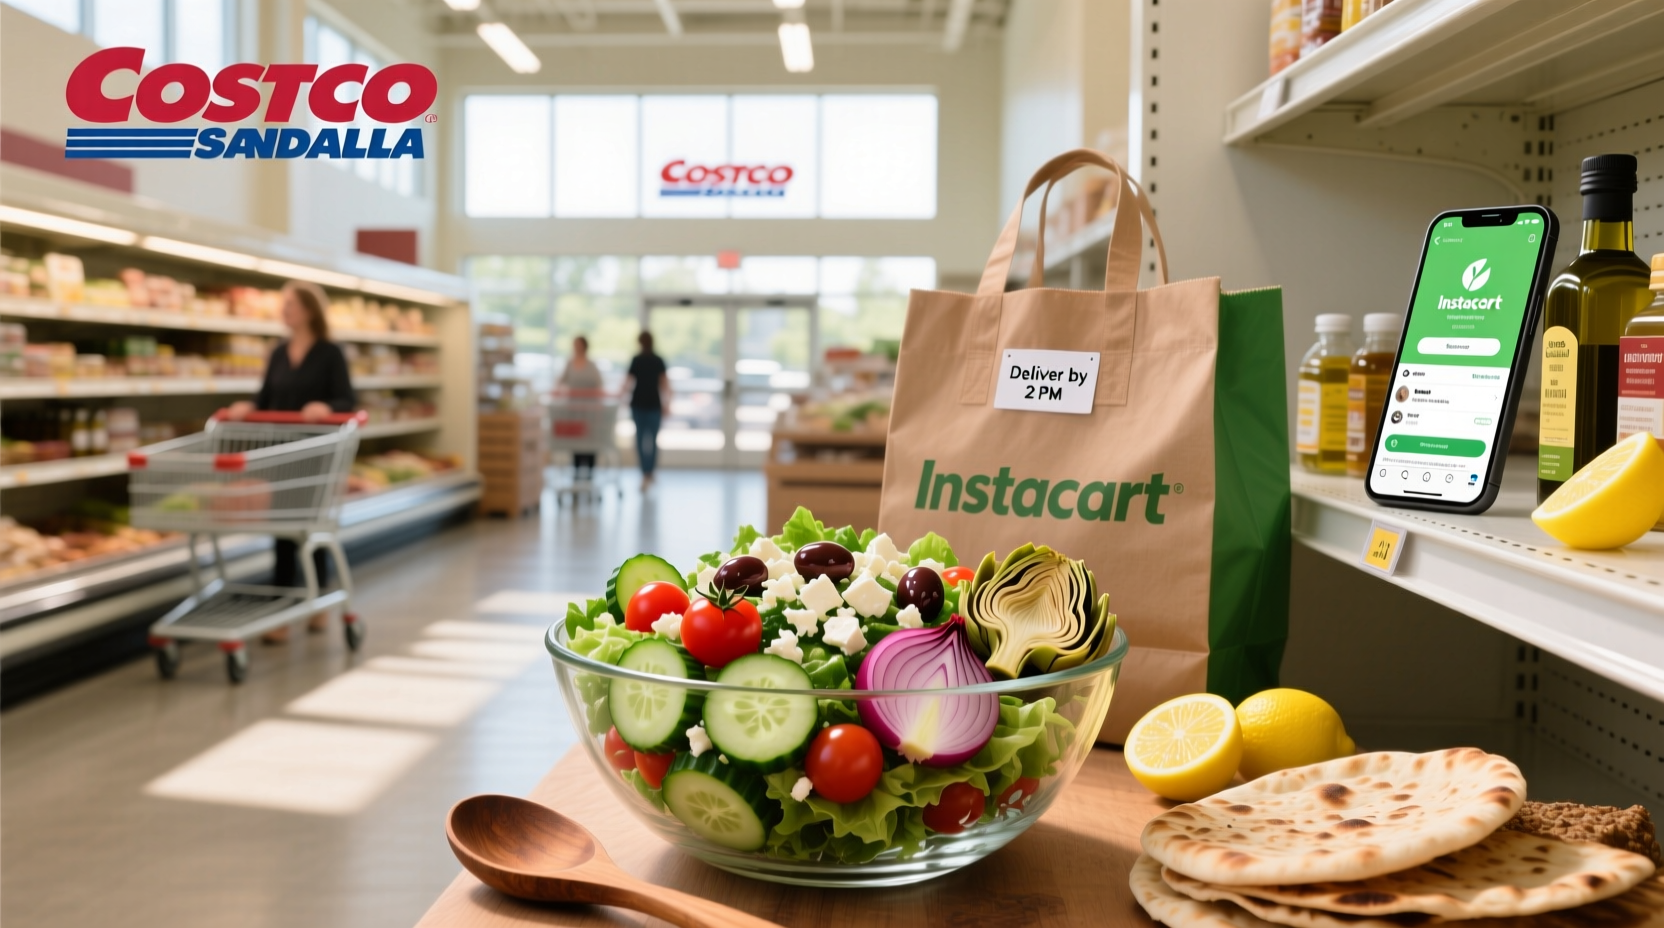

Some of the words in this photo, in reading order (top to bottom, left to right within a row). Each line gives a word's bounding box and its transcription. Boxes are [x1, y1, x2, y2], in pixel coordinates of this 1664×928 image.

[660, 159, 794, 185] COSTCO
[1010, 365, 1064, 381] Deliver
[1068, 367, 1088, 387] by
[1024, 385, 1035, 399] 2
[1038, 386, 1062, 400] PM
[914, 459, 1171, 525] Instacart
